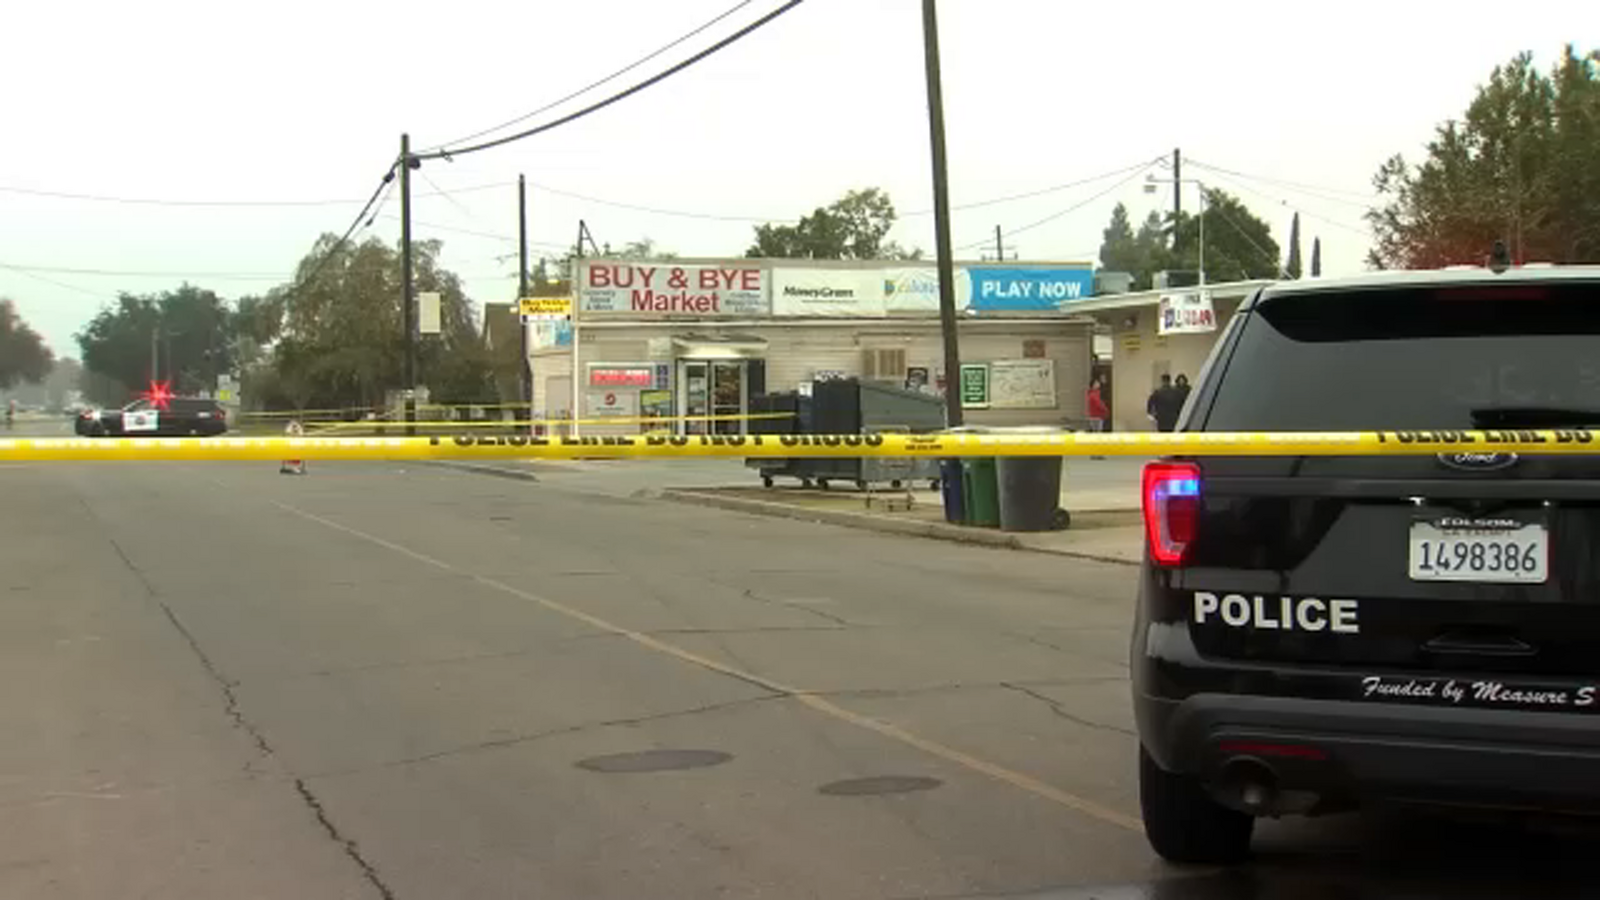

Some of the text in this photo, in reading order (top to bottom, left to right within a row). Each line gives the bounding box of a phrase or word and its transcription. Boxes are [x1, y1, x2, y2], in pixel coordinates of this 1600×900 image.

[589, 265, 760, 290] BUY & BYE
[982, 280, 1081, 298] PLAY NOW
[631, 290, 720, 312] Market
[783, 286, 854, 298] MoneyGram
[1441, 517, 1514, 527] FOLSOM
[1419, 541, 1537, 573] 1498386
[1194, 592, 1360, 634] POLICE
[1362, 676, 1595, 706] Funded by Measure S
